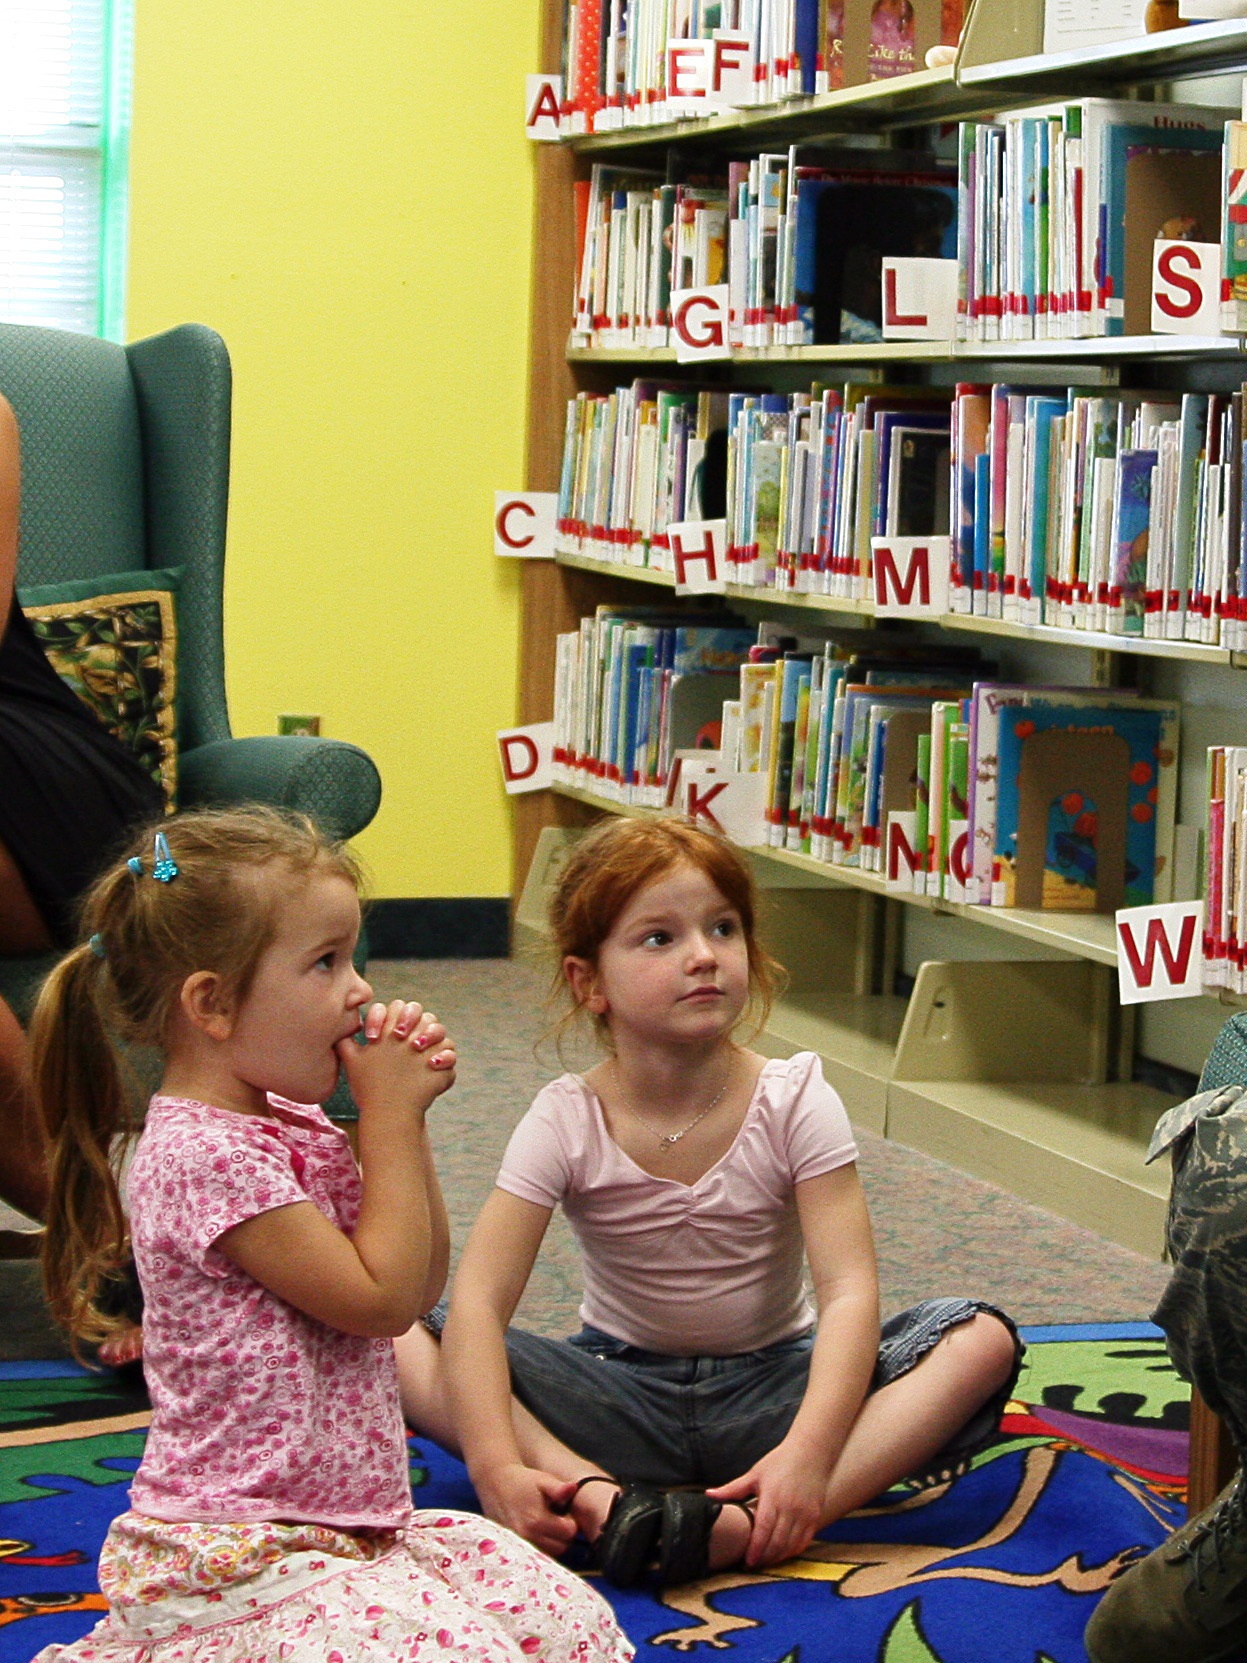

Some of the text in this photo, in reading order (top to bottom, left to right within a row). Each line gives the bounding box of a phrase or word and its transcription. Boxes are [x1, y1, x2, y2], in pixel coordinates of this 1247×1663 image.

[668, 48, 705, 97] E
[712, 41, 749, 92] F
[529, 82, 560, 127] A
[885, 269, 928, 327] L
[1153, 245, 1203, 319] S
[672, 295, 724, 349] G
[496, 501, 536, 549] C
[672, 531, 718, 585] H
[873, 547, 931, 605] M
[499, 735, 540, 781] D
[687, 783, 729, 836] K
[1118, 915, 1197, 987] W
